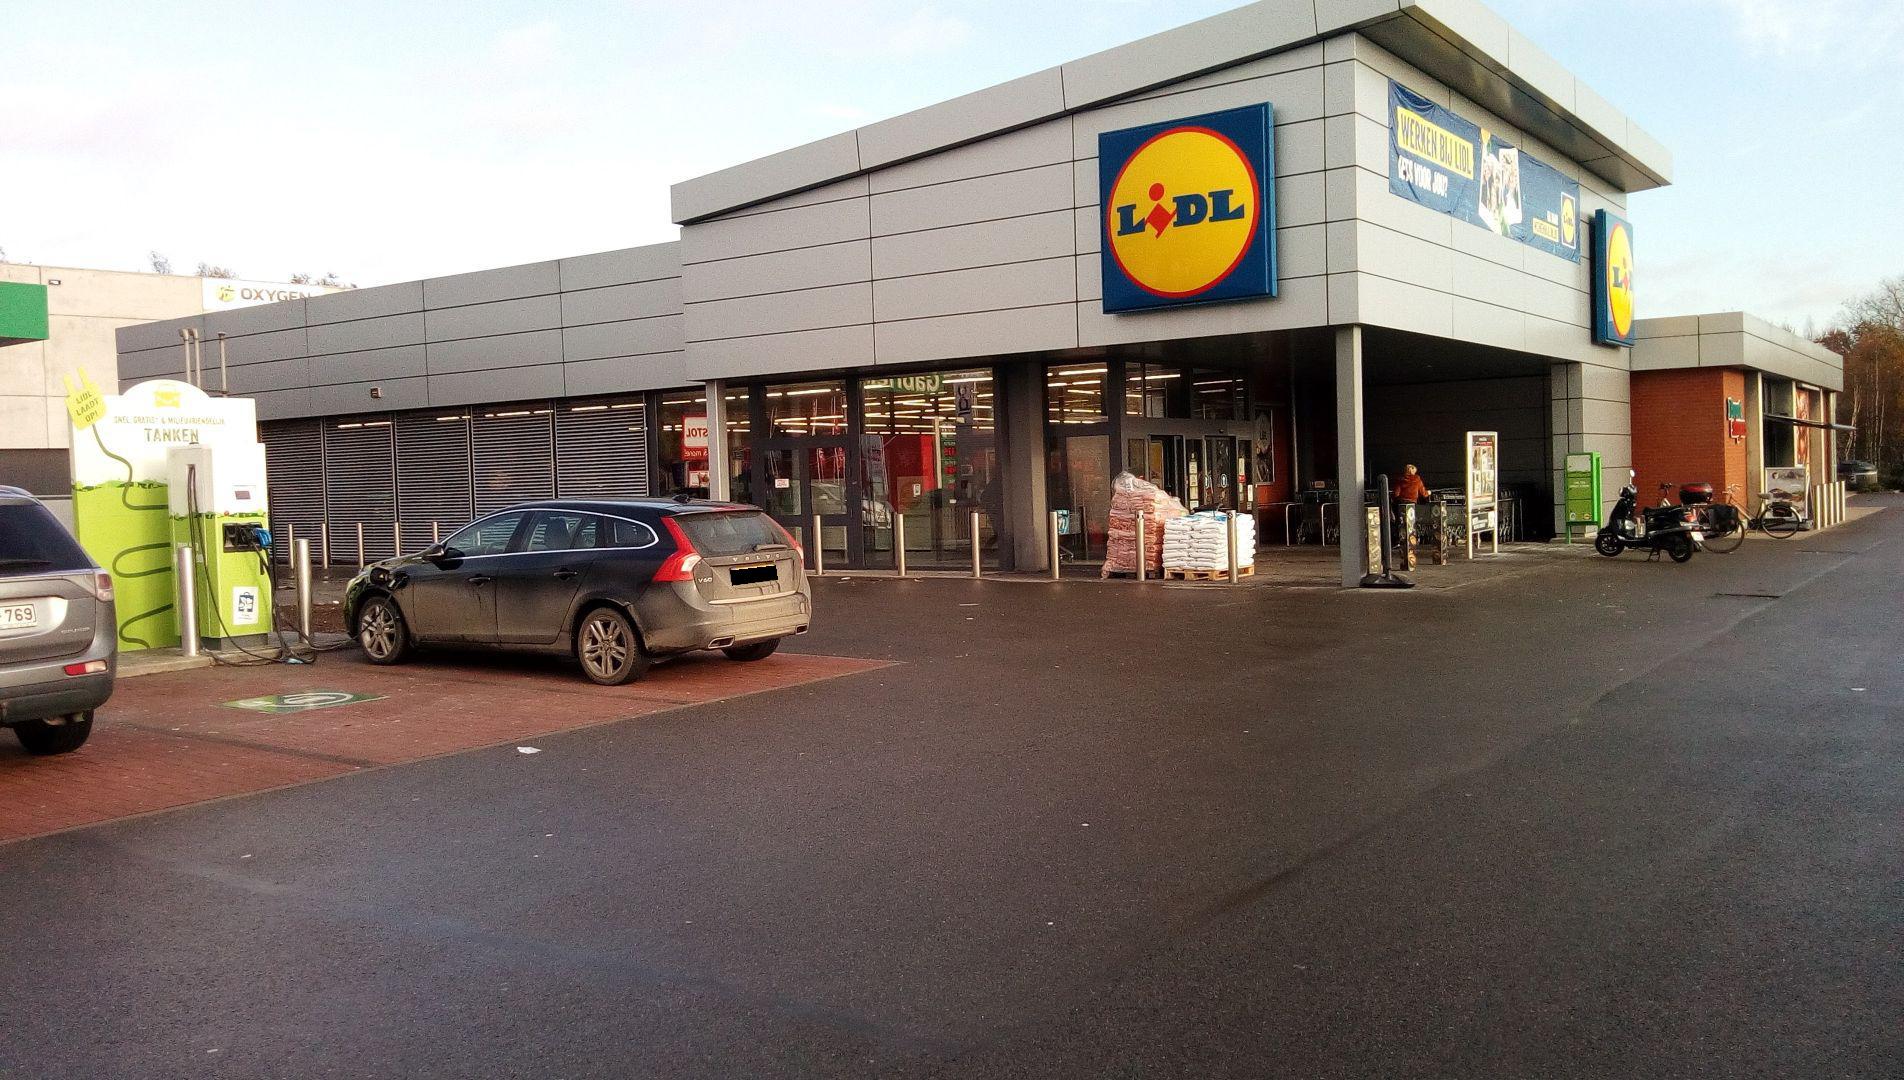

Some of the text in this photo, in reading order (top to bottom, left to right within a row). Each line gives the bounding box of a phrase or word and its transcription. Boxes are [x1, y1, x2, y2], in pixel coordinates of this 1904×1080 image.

[1400, 113, 1472, 175] WERKEN BIJ LIDL
[75, 391, 93, 405] LIDL
[76, 399, 99, 416] LAADT
[85, 411, 98, 423] OP!
[144, 428, 199, 442] TANKEN
[733, 553, 780, 562] VOLVO
